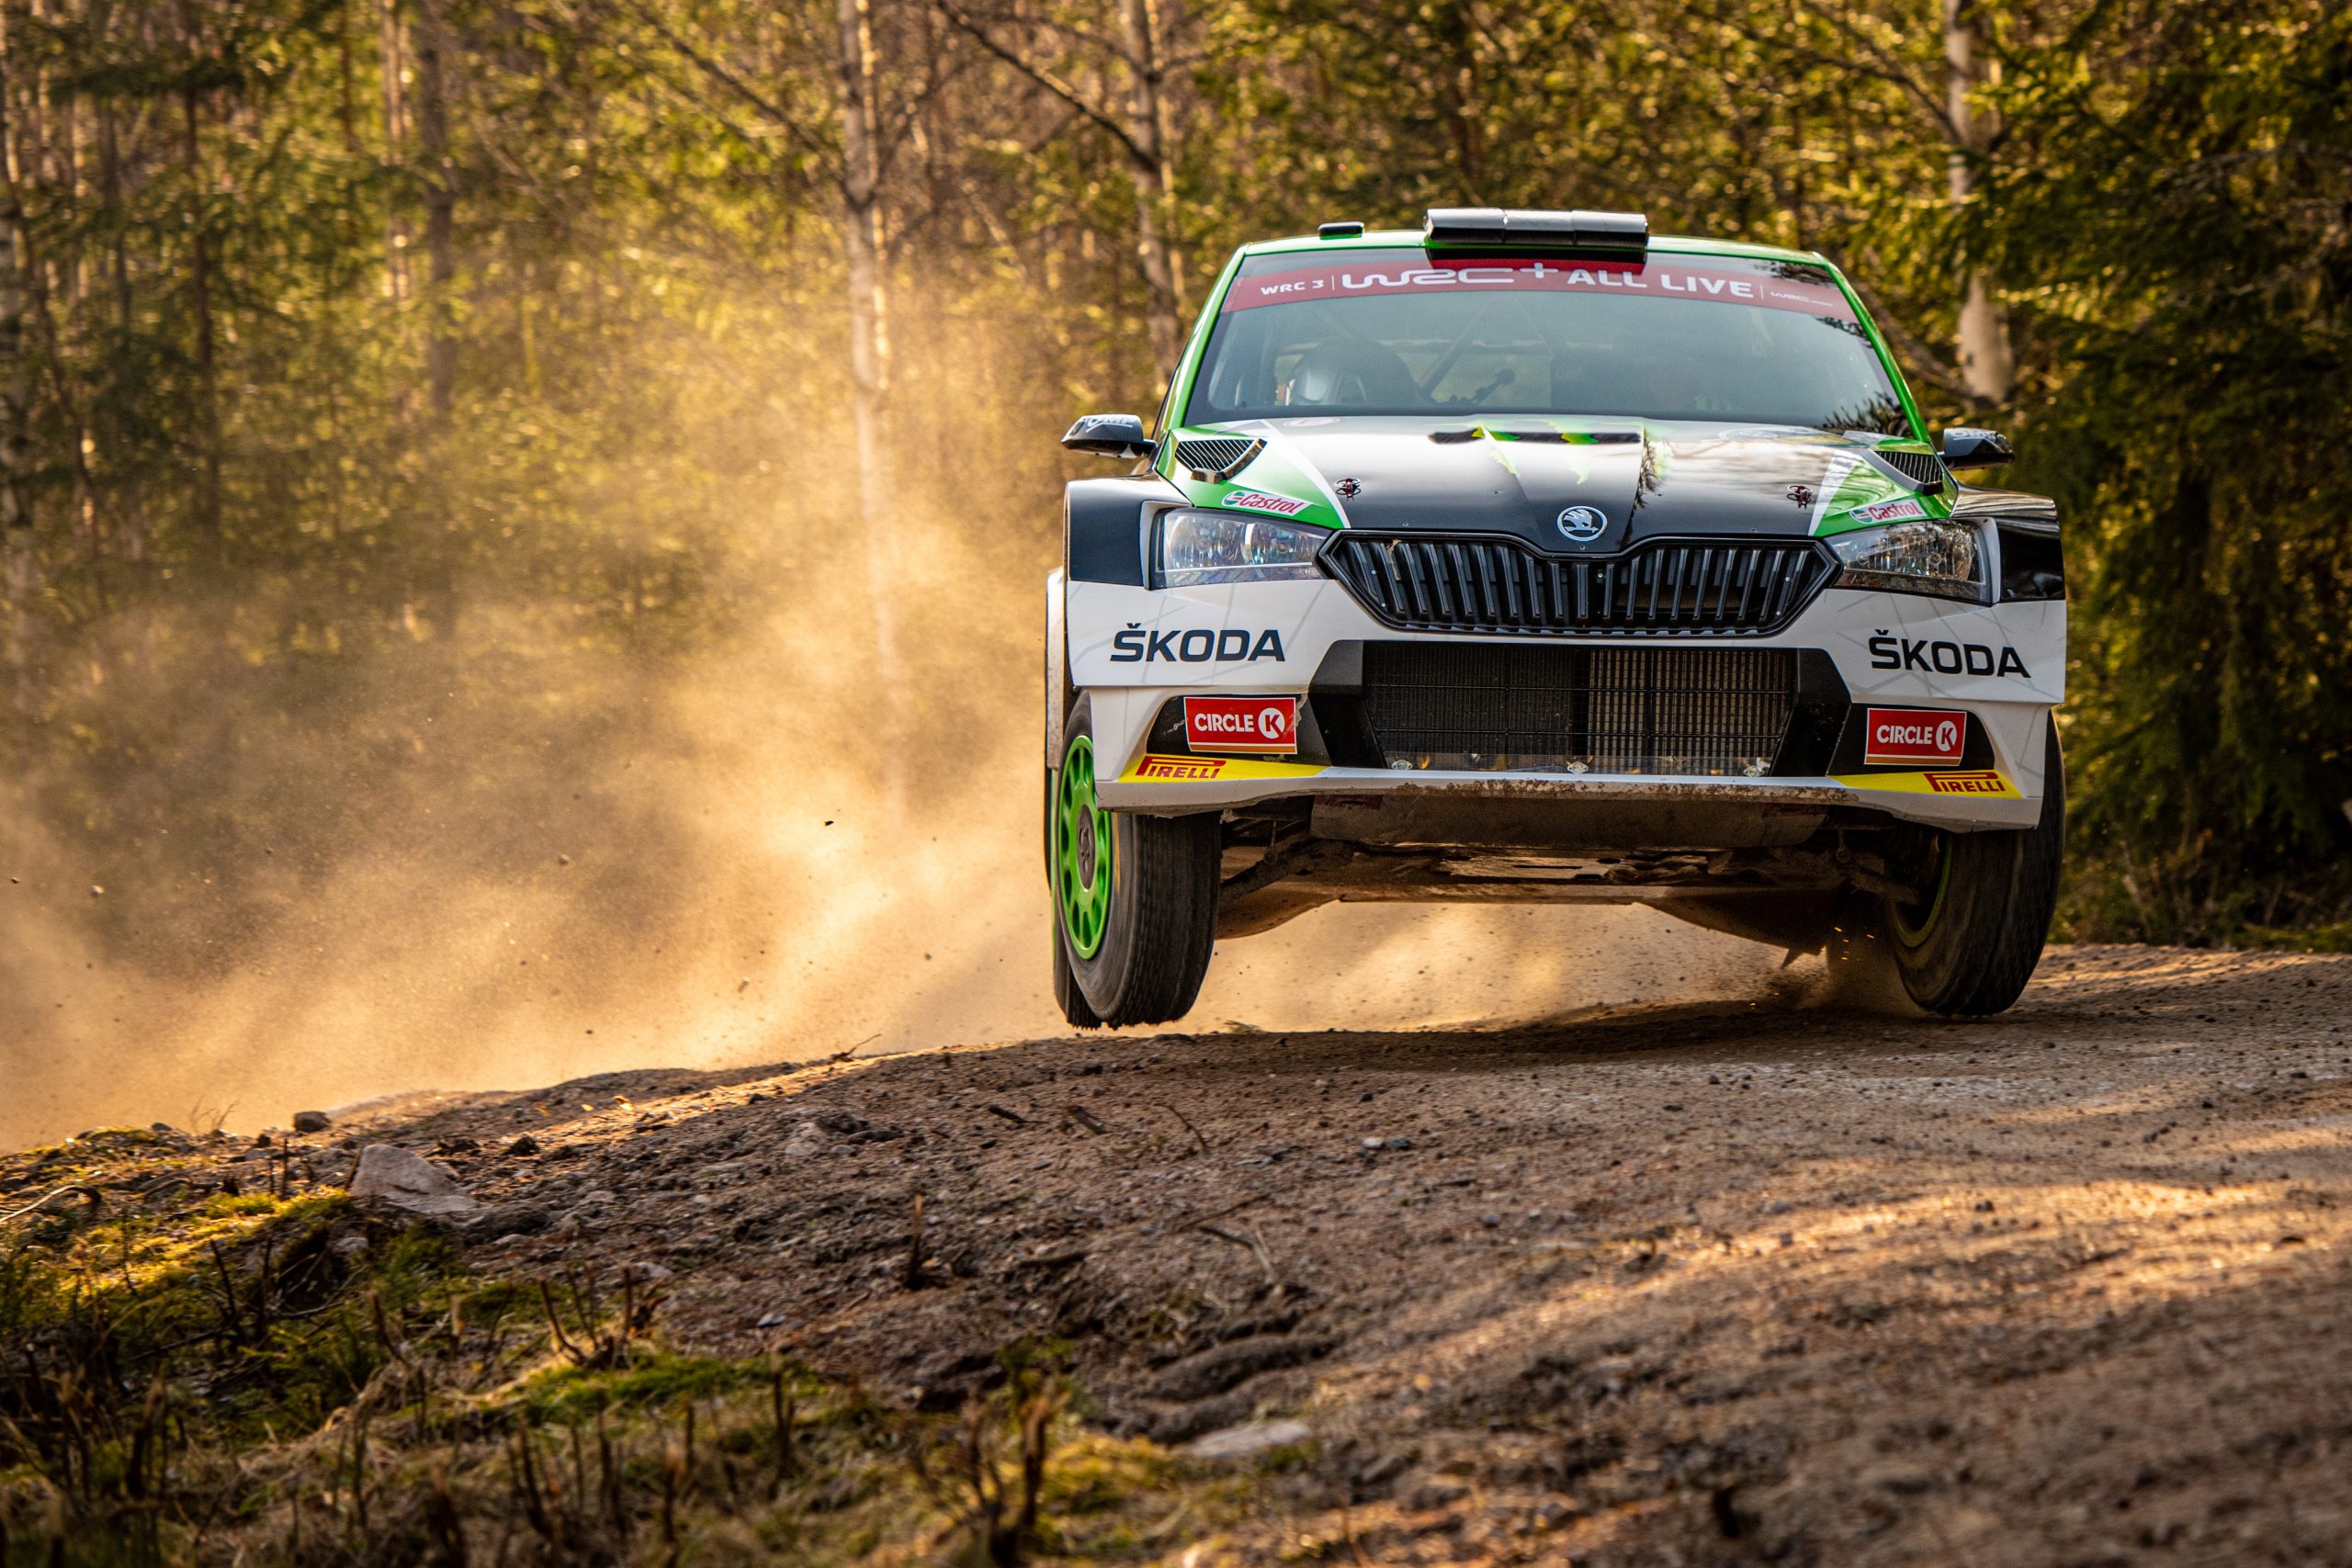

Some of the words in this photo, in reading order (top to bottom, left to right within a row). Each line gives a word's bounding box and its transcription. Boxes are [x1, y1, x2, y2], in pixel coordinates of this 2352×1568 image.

[1261, 280, 1306, 296] WRC
[1312, 279, 1325, 289] 3
[1566, 269, 1647, 288] ALL
[1660, 274, 1754, 299] LIVE
[1238, 493, 1305, 513] Castrol
[1868, 502, 1923, 521] Castrol
[1110, 623, 1285, 662] ŠKODA
[1868, 629, 2031, 678] ŠKODA
[1194, 713, 1254, 733] CIRCLE
[1263, 713, 1284, 735] K
[1876, 725, 1933, 745] CIRCLE
[1939, 725, 1956, 747] K
[1136, 756, 1227, 779] PIRELLI
[1922, 772, 2006, 793] PIRELLI
